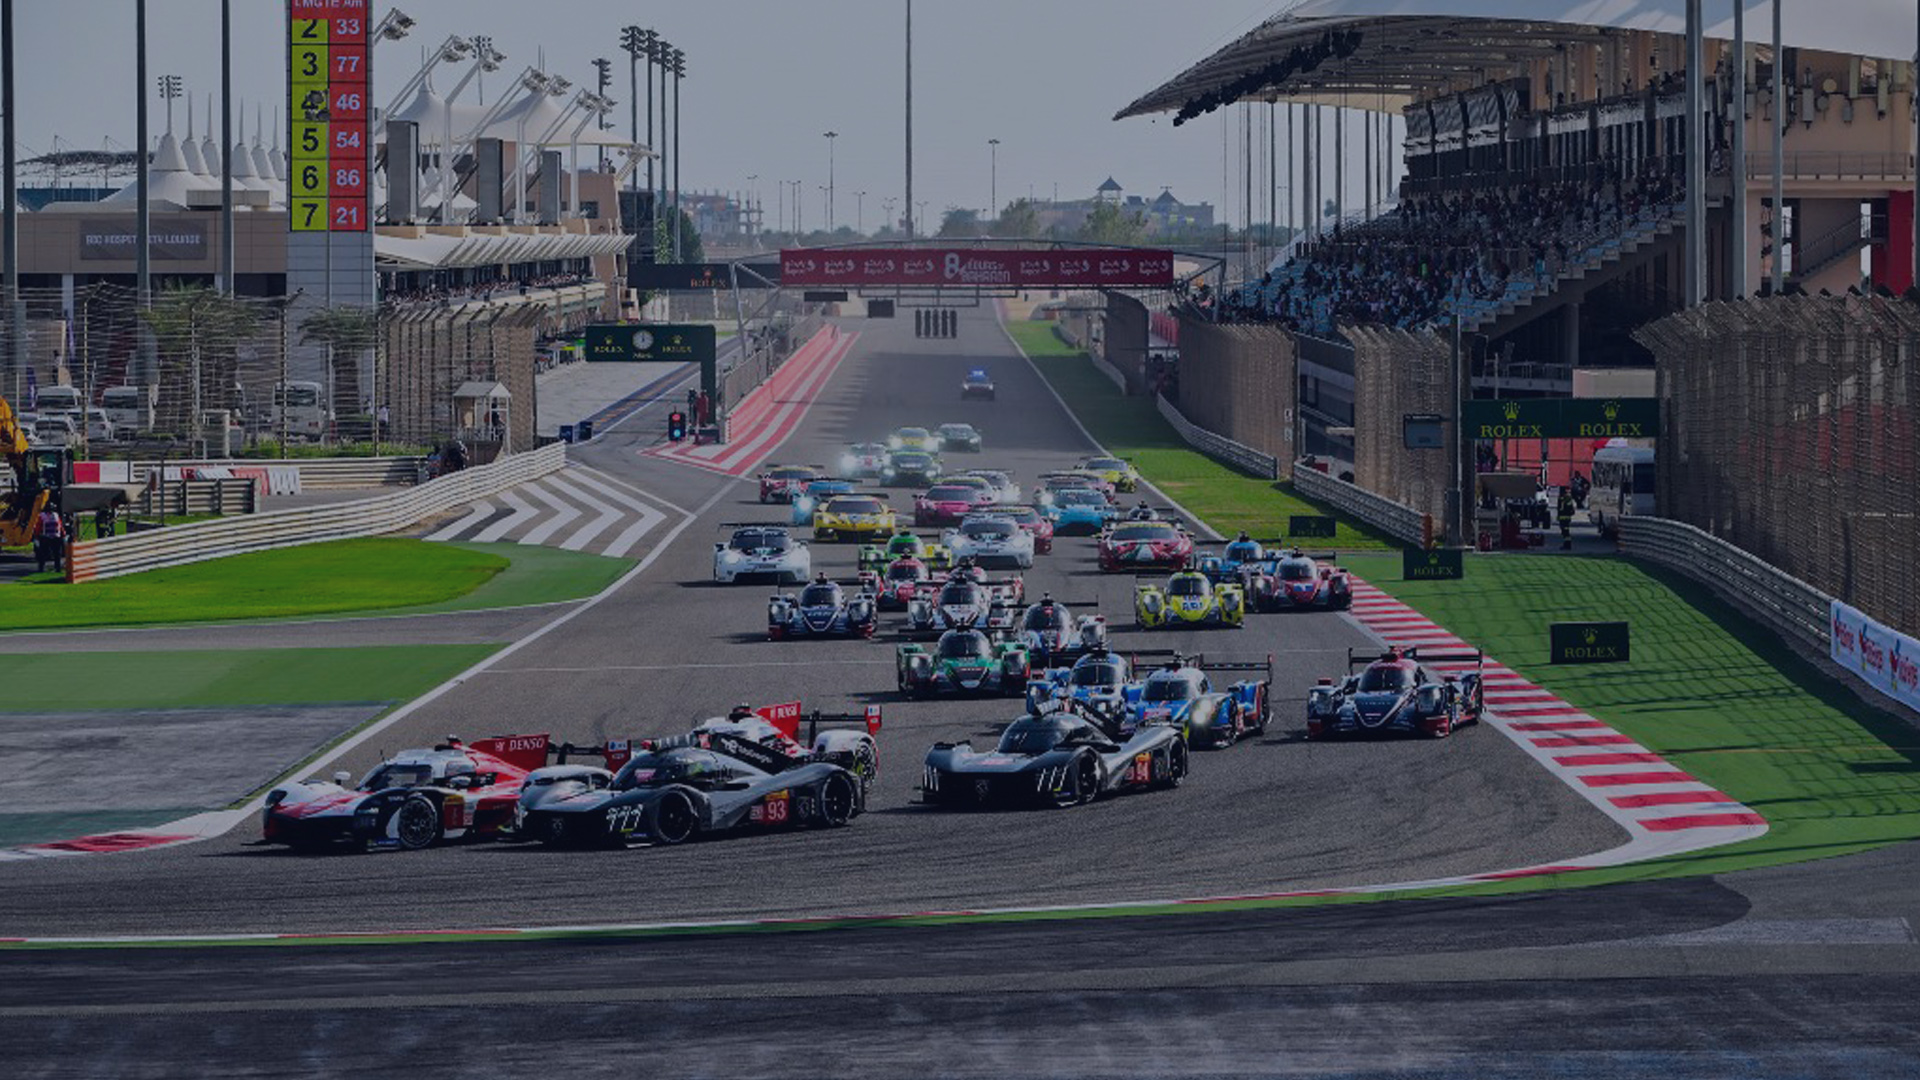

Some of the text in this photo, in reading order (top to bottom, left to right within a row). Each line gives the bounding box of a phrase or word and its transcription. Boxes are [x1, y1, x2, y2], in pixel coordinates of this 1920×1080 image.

[302, 19, 360, 38] 2 33
[302, 52, 360, 76] 3 77
[336, 94, 360, 110] 46
[302, 128, 360, 151] 5 54
[302, 166, 360, 190] 6 86
[302, 203, 357, 227] 7 21
[944, 252, 960, 280] 8
[1480, 423, 1642, 438] ROLEX ROLEX
[1413, 566, 1453, 576] ROLEX
[1564, 647, 1617, 659] ROLEX
[509, 737, 545, 752] DENSO
[767, 800, 787, 820] 93
